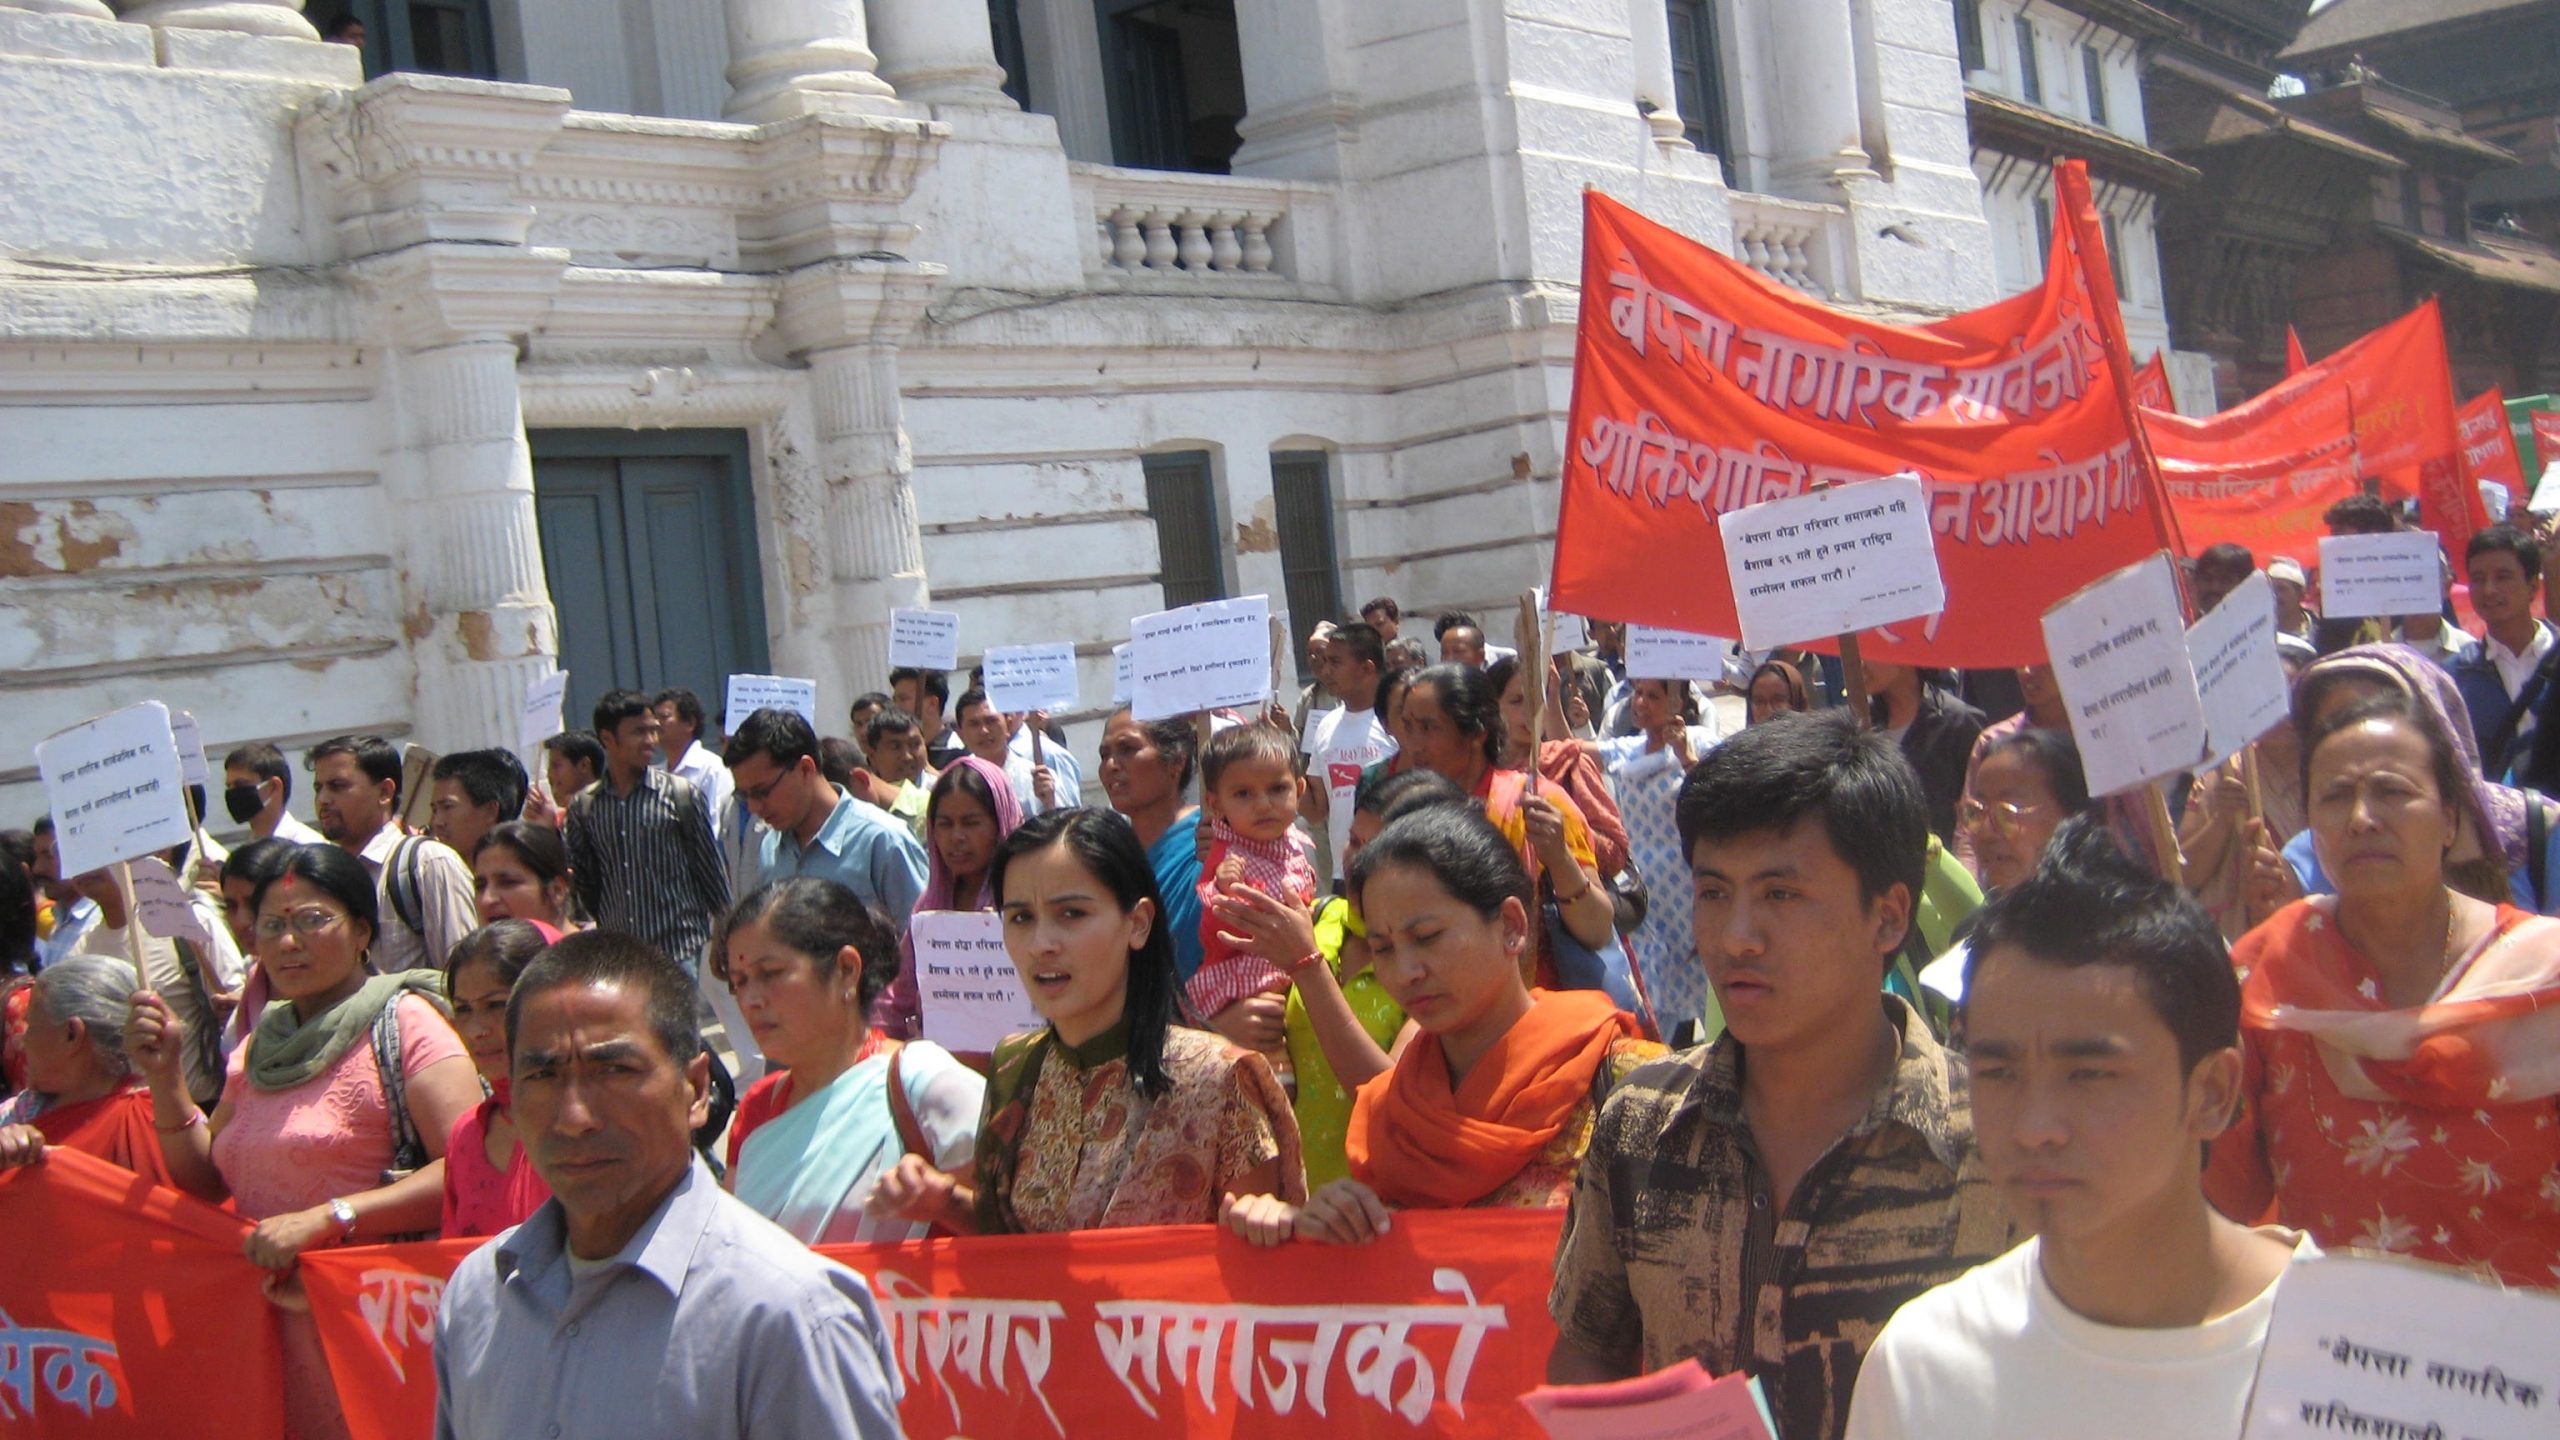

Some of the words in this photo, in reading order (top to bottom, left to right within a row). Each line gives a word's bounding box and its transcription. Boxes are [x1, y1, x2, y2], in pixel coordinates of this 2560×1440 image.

[1736, 331, 1947, 430] नागरिक
[1804, 516, 1840, 531] परिवार
[1844, 505, 1886, 523] समाजको
[1975, 447, 2107, 547] आयोग
[1790, 575, 1817, 590] सफल
[874, 1269, 1067, 1440] रिवार
[1094, 1266, 1510, 1427] समाजको
[2426, 1360, 2545, 1408] नागरिक
